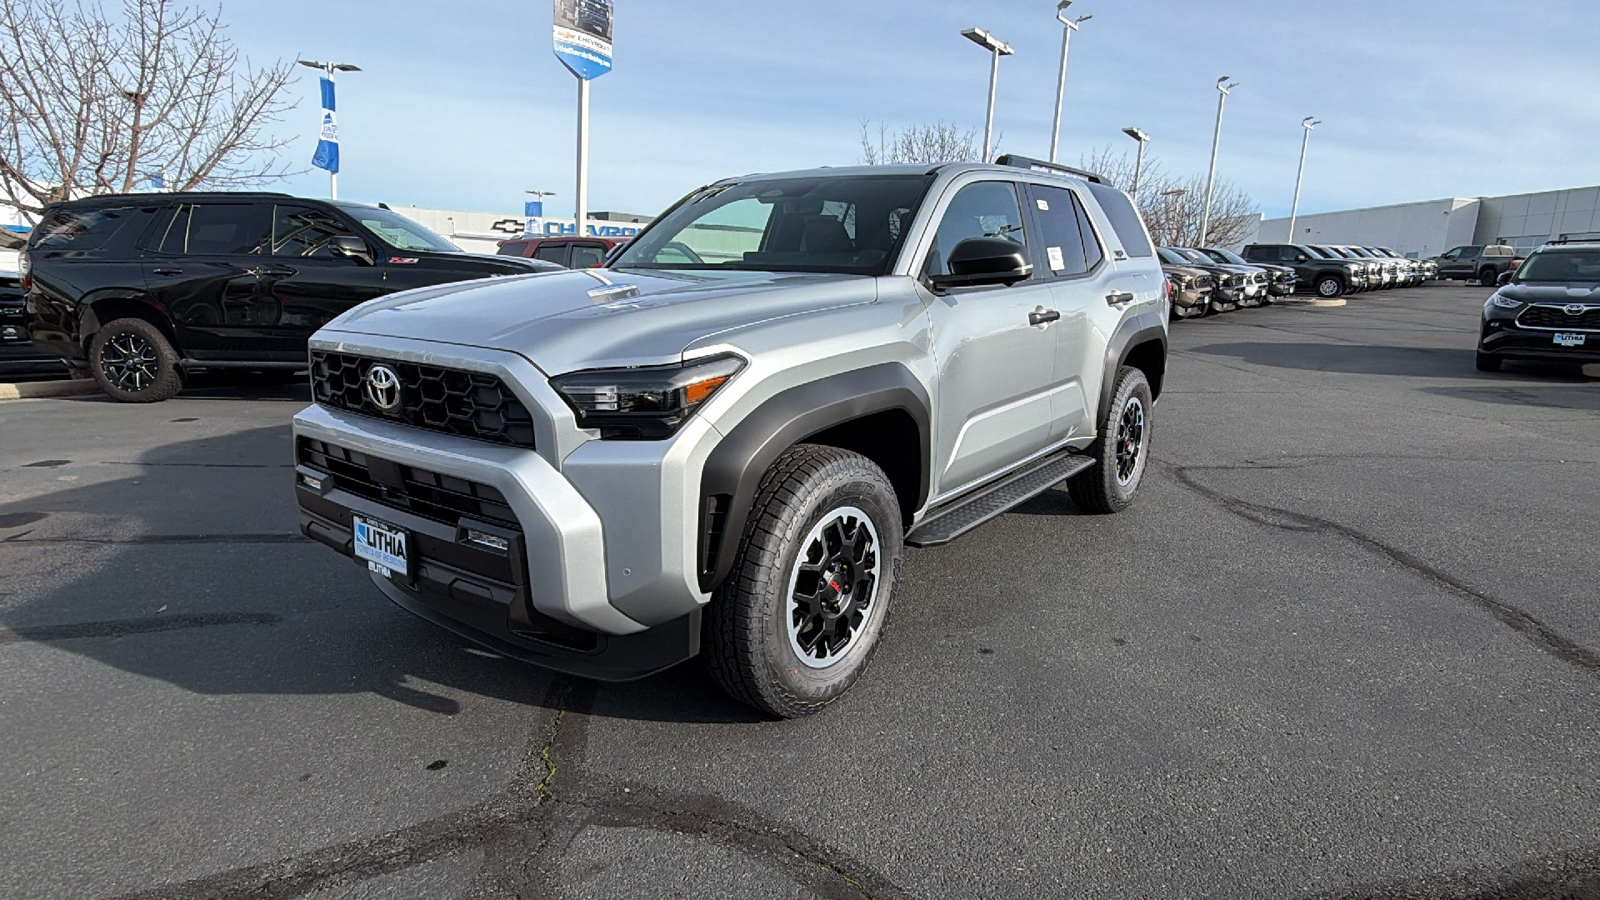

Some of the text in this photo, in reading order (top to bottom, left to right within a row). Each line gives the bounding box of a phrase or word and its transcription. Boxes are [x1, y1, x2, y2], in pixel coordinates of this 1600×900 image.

[577, 35, 610, 51] CHEVROLET
[366, 525, 406, 560] LITHIA
[356, 542, 406, 570] TOYOTA OF REDDING
[373, 562, 392, 578] LITHIA
